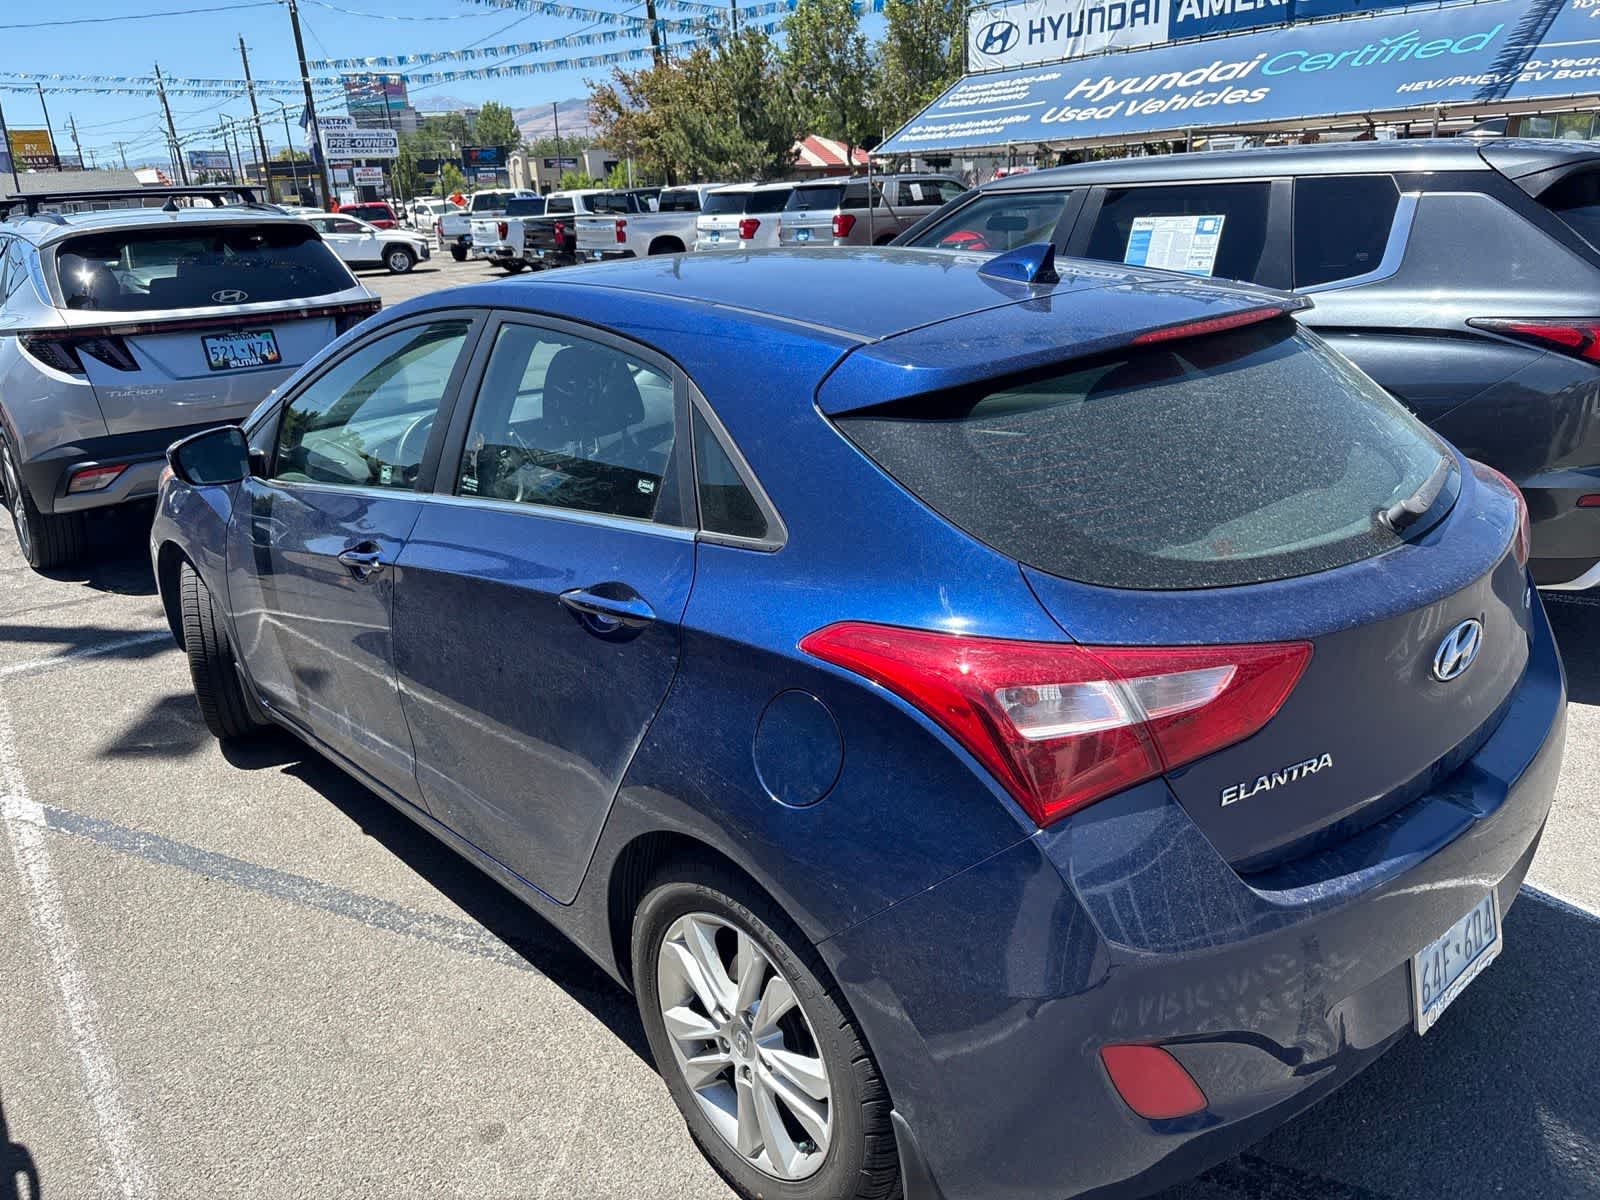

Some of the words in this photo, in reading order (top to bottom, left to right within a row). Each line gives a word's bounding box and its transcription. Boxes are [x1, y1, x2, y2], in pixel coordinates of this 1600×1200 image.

[1028, 0, 1160, 45] HYUNDAI
[1064, 52, 1268, 102] Hyundai
[1261, 24, 1505, 76] Certified
[317, 118, 353, 126] KIETZKE
[1040, 101, 1125, 124] Used
[1124, 85, 1271, 118] Vehicles
[329, 139, 395, 148] PRE-OWNED
[1221, 752, 1333, 807] ELANTRA
